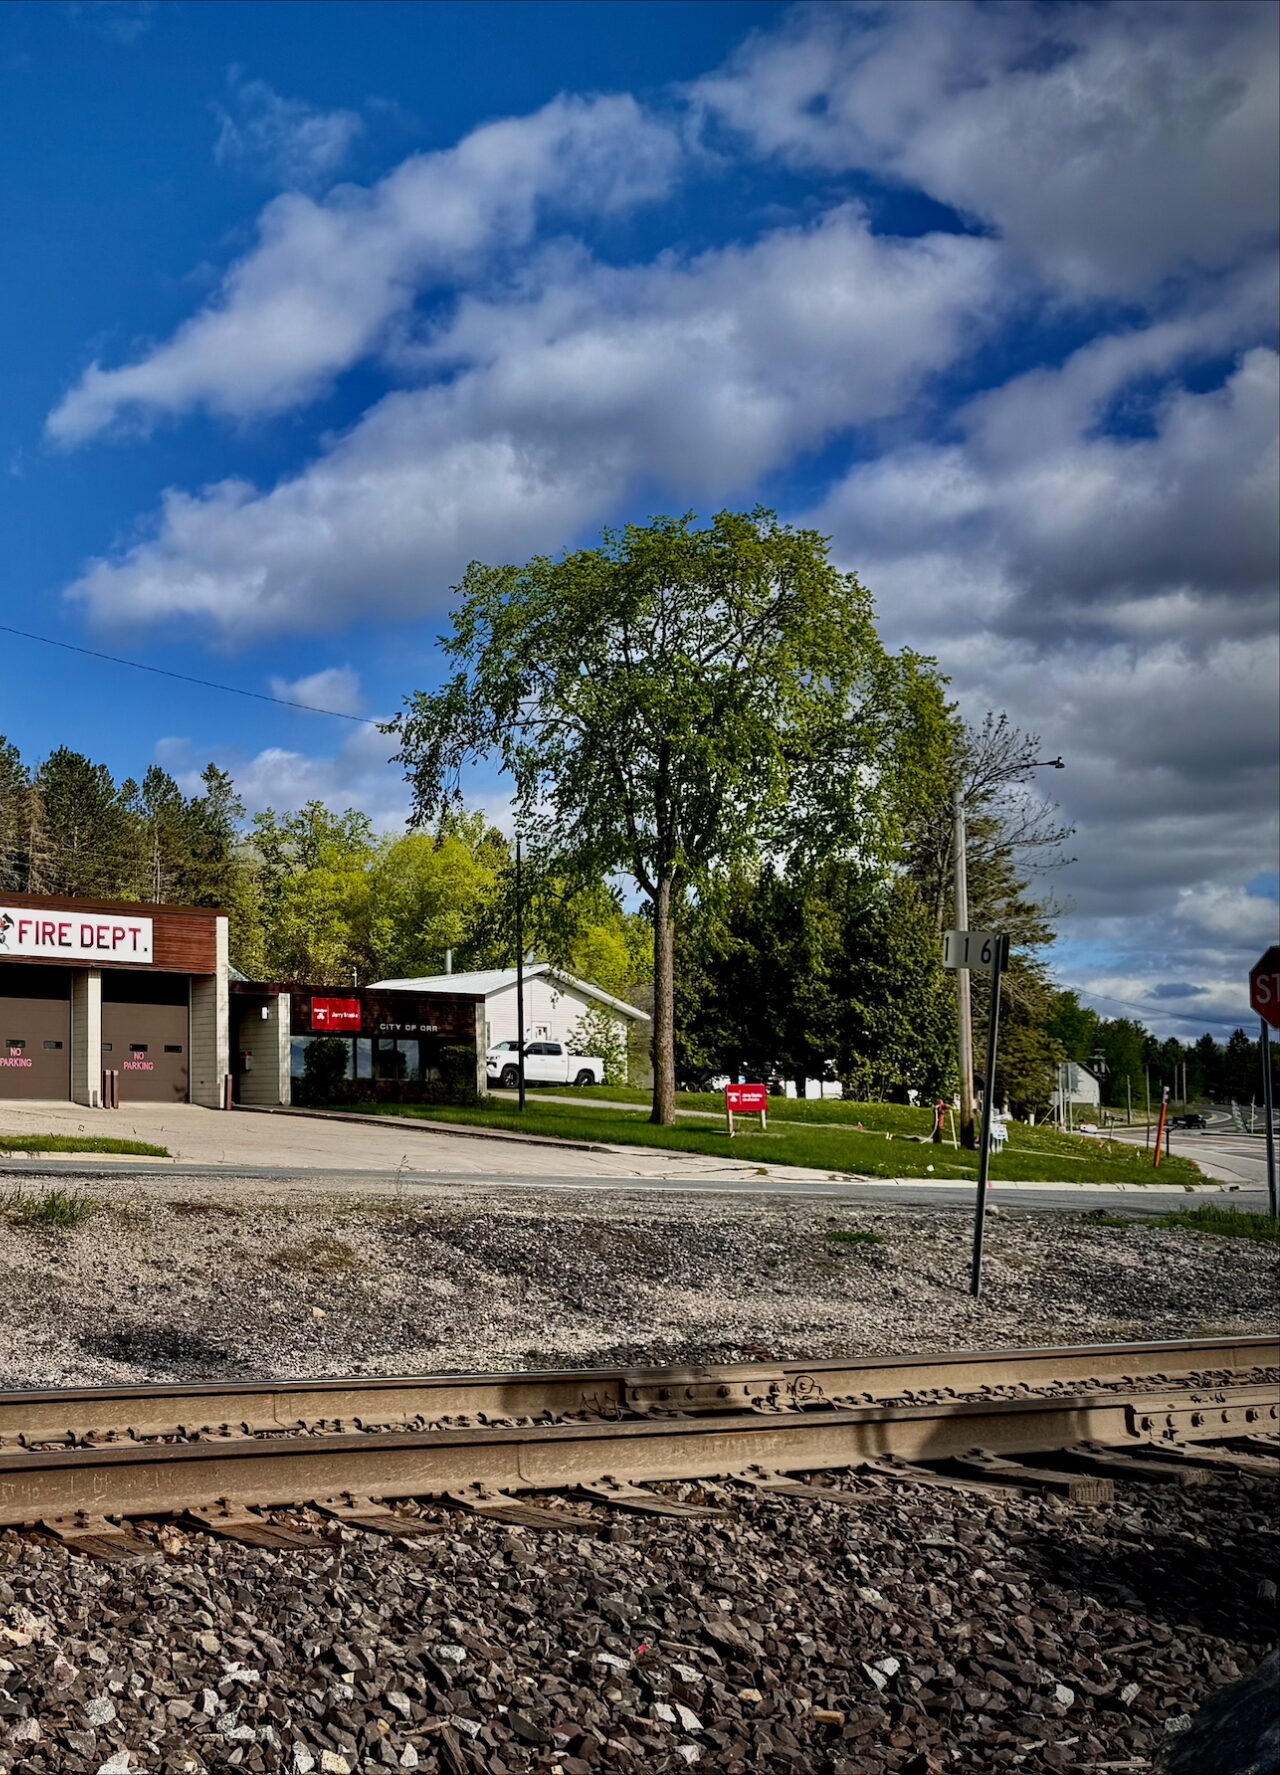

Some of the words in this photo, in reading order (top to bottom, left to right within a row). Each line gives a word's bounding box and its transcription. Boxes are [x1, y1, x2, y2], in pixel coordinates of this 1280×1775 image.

[18, 919, 73, 948] FIRE
[80, 923, 149, 953] DEPT.
[379, 1023, 402, 1031] CITY
[404, 1024, 417, 1032] OF
[419, 1025, 438, 1033] ORR
[10, 1048, 22, 1057] NO
[133, 1051, 145, 1061] NO
[0, 1058, 32, 1068] PARKING
[123, 1061, 154, 1072] PARKING
